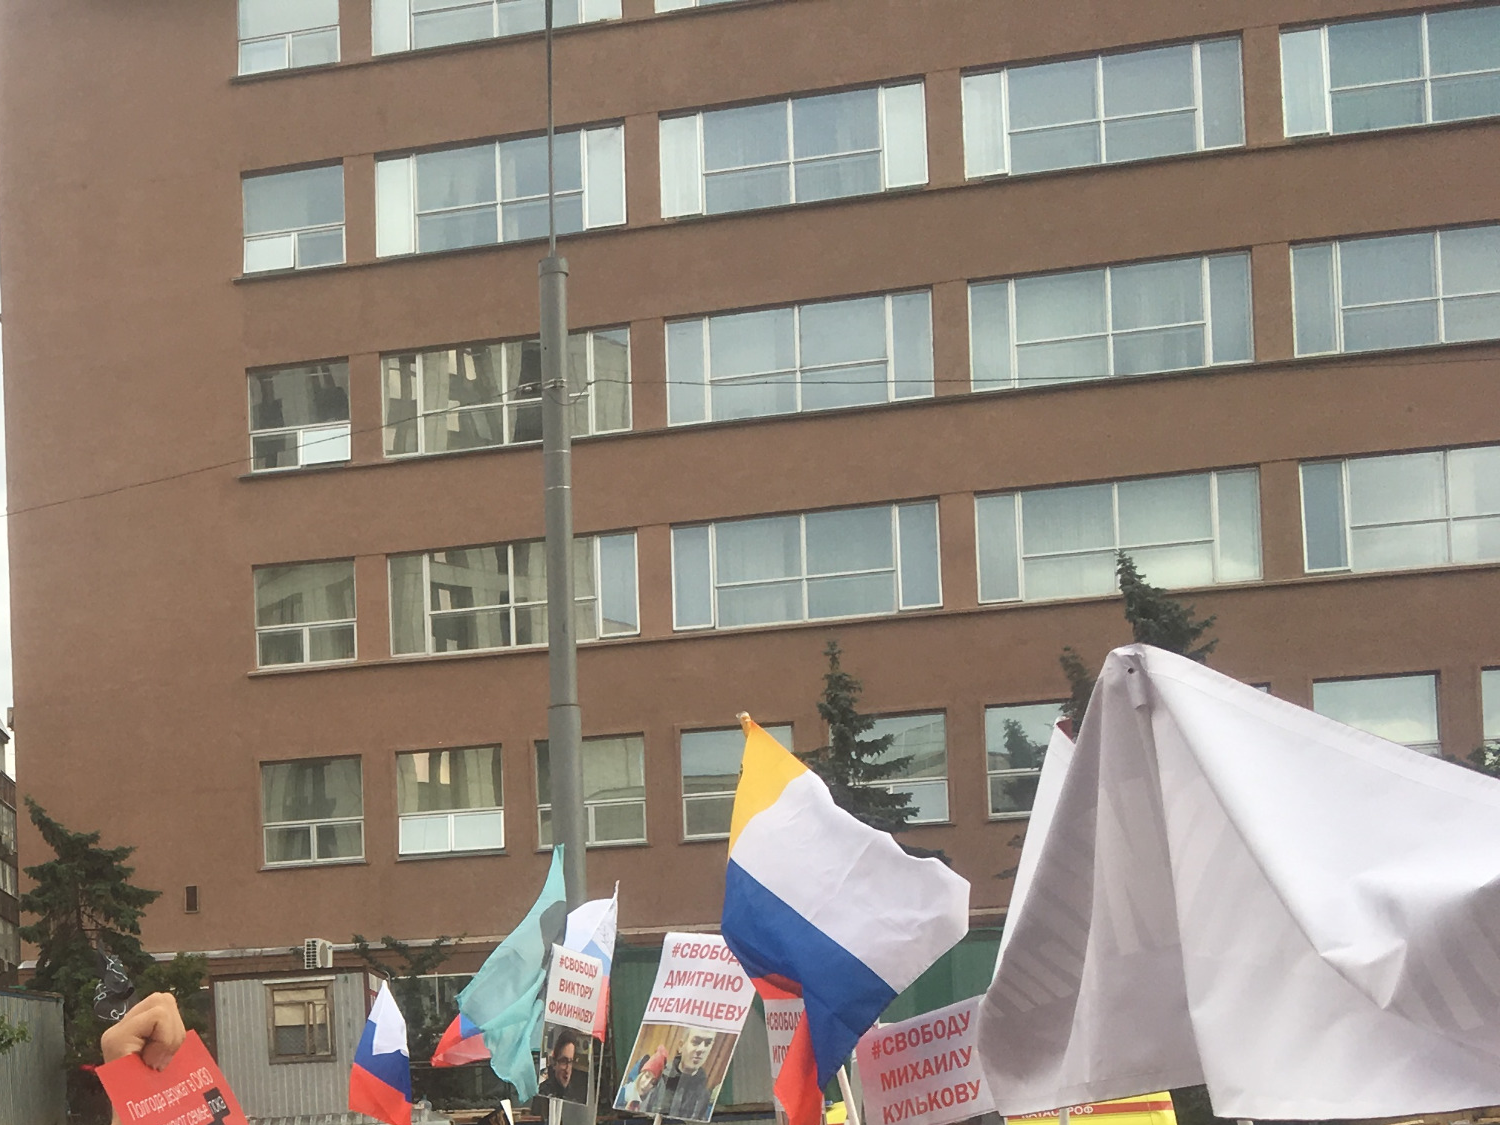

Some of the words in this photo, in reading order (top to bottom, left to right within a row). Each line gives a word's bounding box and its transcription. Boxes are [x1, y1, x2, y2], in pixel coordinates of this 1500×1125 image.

[559, 955, 599, 980] #СВОБОДУ
[558, 978, 595, 1000] ВИКТОРУ
[663, 970, 744, 993] ДМИТРИЮ
[548, 999, 595, 1024] ФИЛИНКОВУ
[648, 996, 748, 1022] ПЧЕЛИНЦЕВУ
[871, 1010, 971, 1060] #СВОБОДУ
[189, 1066, 214, 1090] СИЗО
[880, 1045, 973, 1092] МИХАИЛУ
[162, 1081, 191, 1107] держат
[186, 1079, 197, 1093] в
[126, 1092, 167, 1121] Полгода
[882, 1079, 982, 1125] КУЛЬКОВУ
